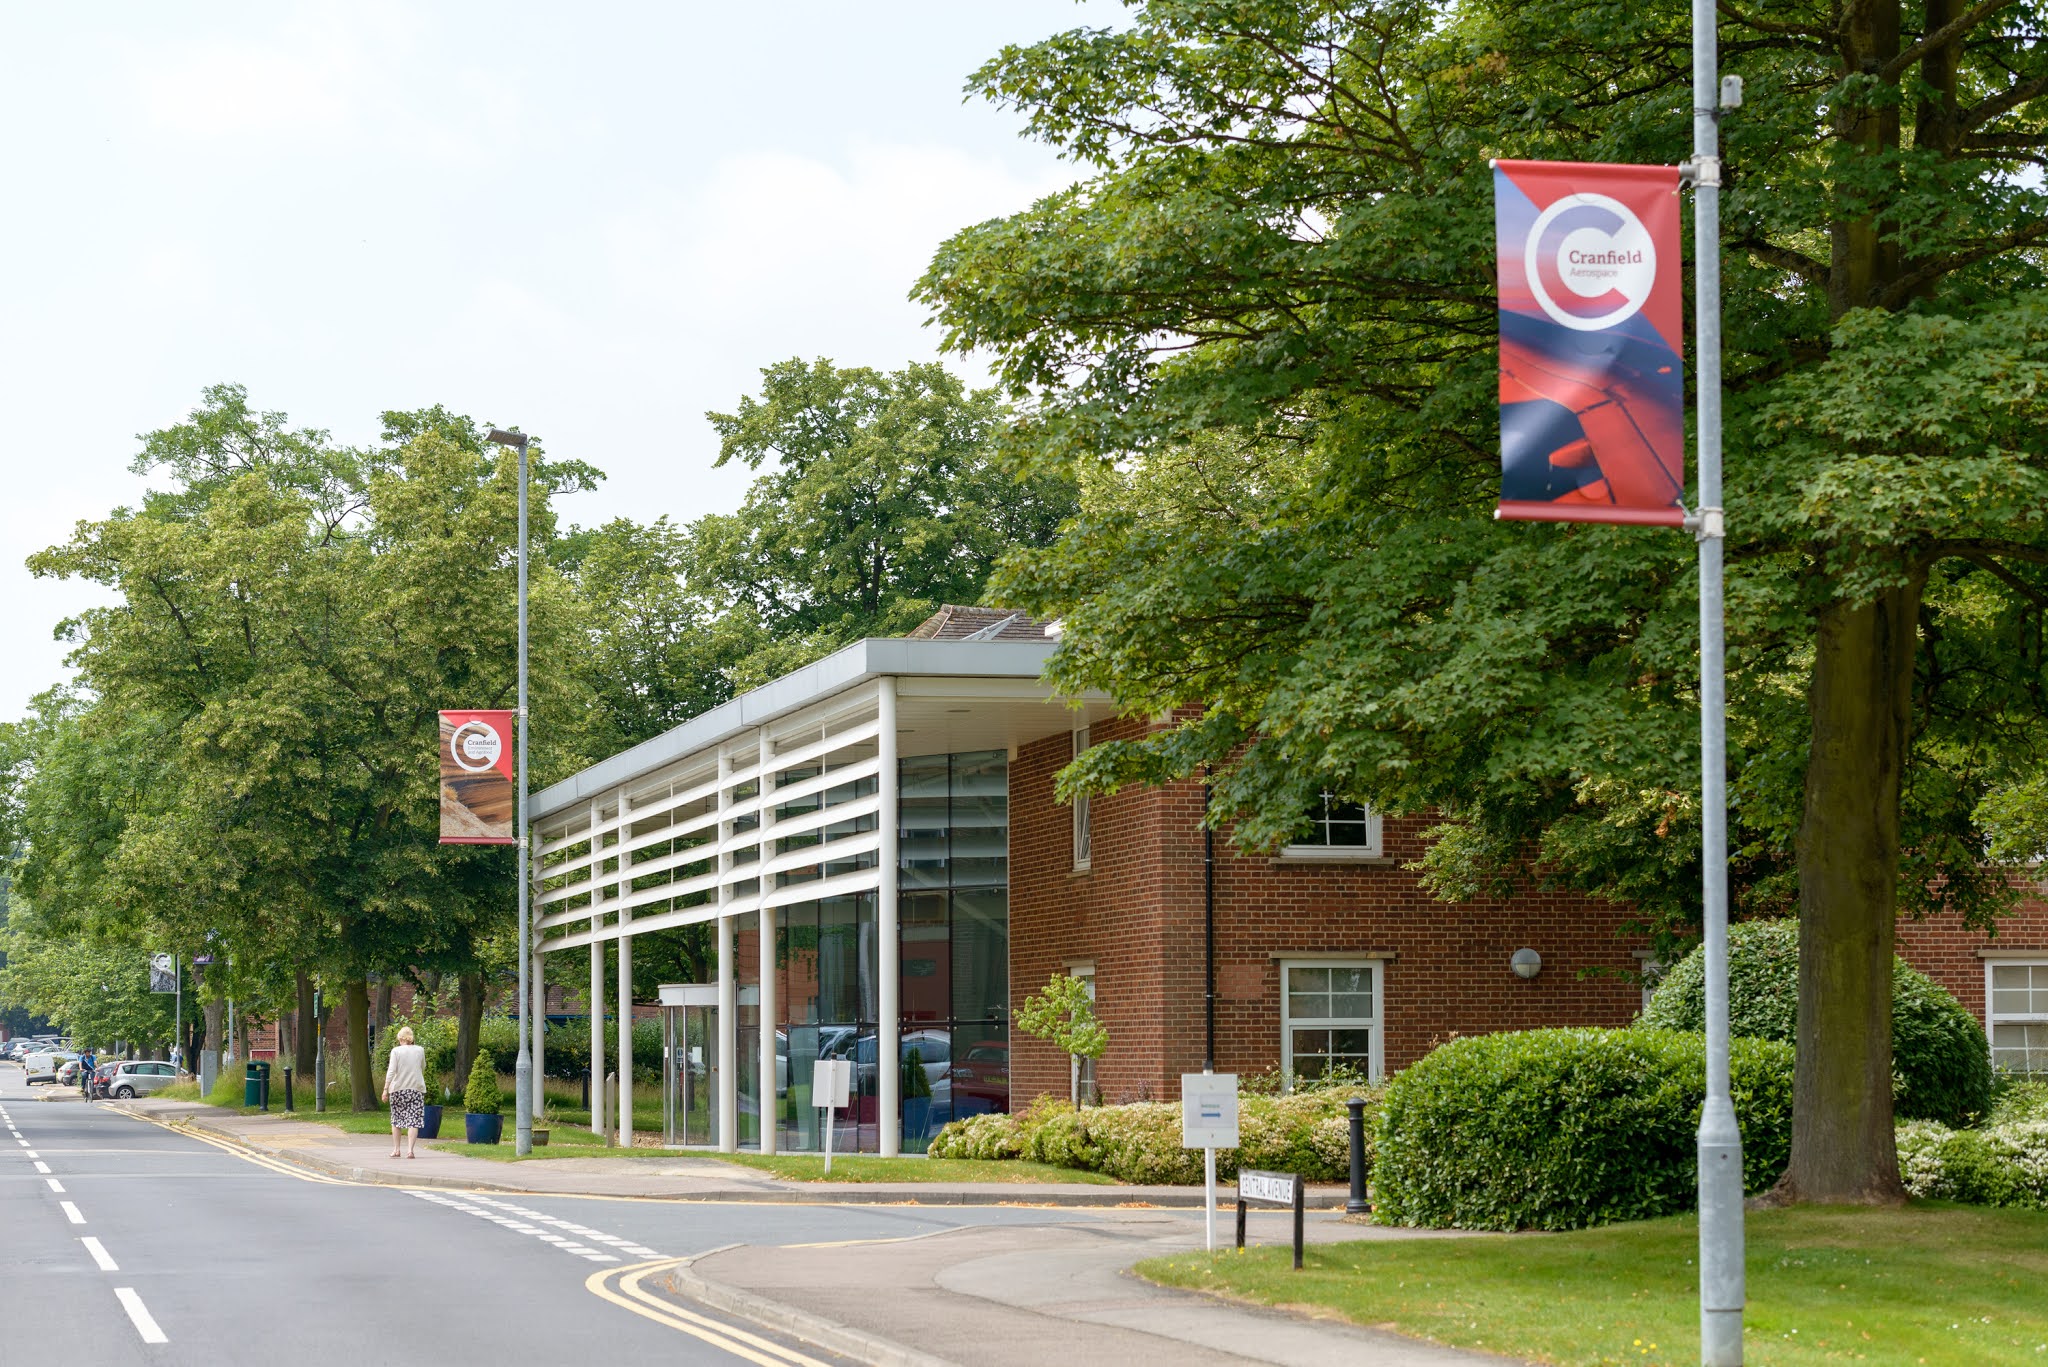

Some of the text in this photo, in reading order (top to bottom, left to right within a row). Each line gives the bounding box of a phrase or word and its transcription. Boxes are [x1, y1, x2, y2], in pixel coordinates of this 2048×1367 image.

[1569, 250, 1642, 265] Cranfield
[1569, 267, 1618, 280] Aerospace
[1242, 1176, 1291, 1201] CENTRAL AVENUE
